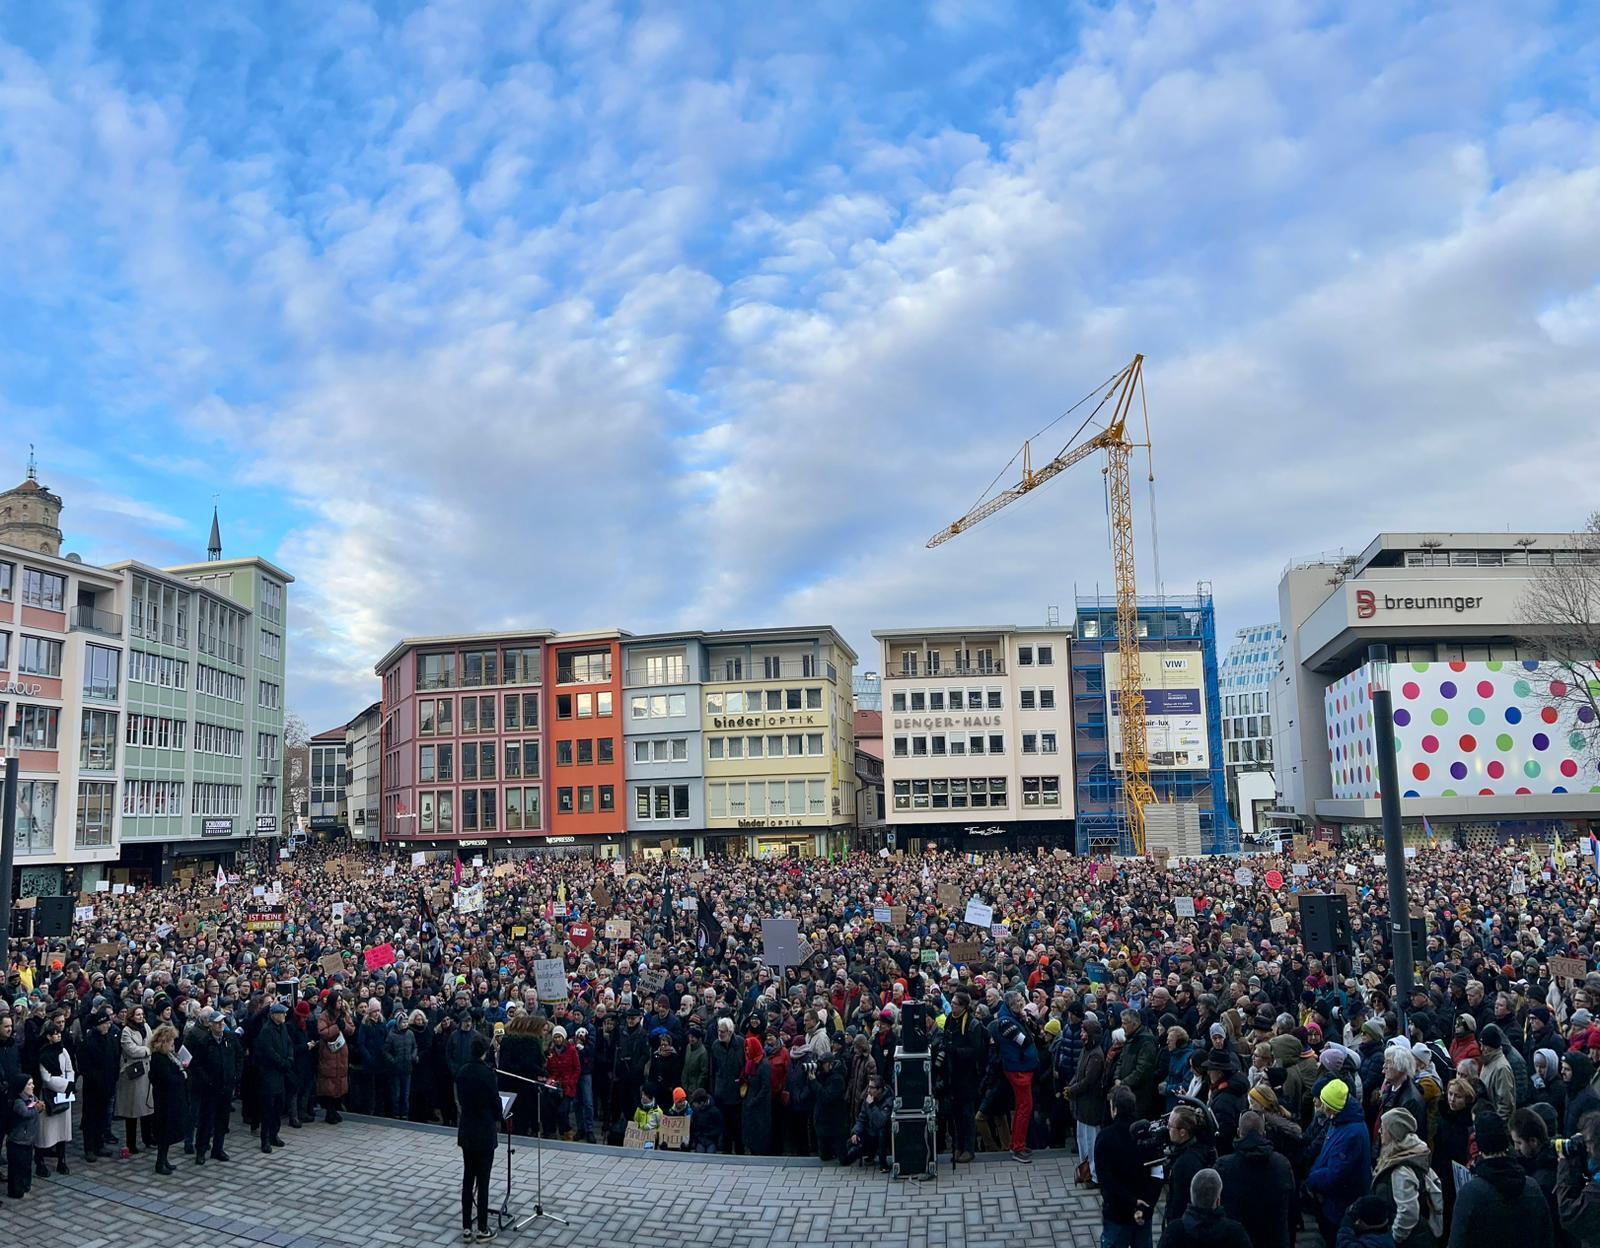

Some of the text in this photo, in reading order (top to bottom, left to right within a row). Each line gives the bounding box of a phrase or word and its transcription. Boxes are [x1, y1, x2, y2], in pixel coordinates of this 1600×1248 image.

[1384, 594, 1483, 612] breuninger
[0, 680, 42, 696] GROUP
[714, 716, 760, 728] binder
[738, 819, 802, 827] binder OPTIK
[458, 839, 488, 847] NESPRESSO
[545, 836, 575, 844] NESPRESSO
[257, 905, 272, 913] HIER
[249, 913, 259, 921] IST
